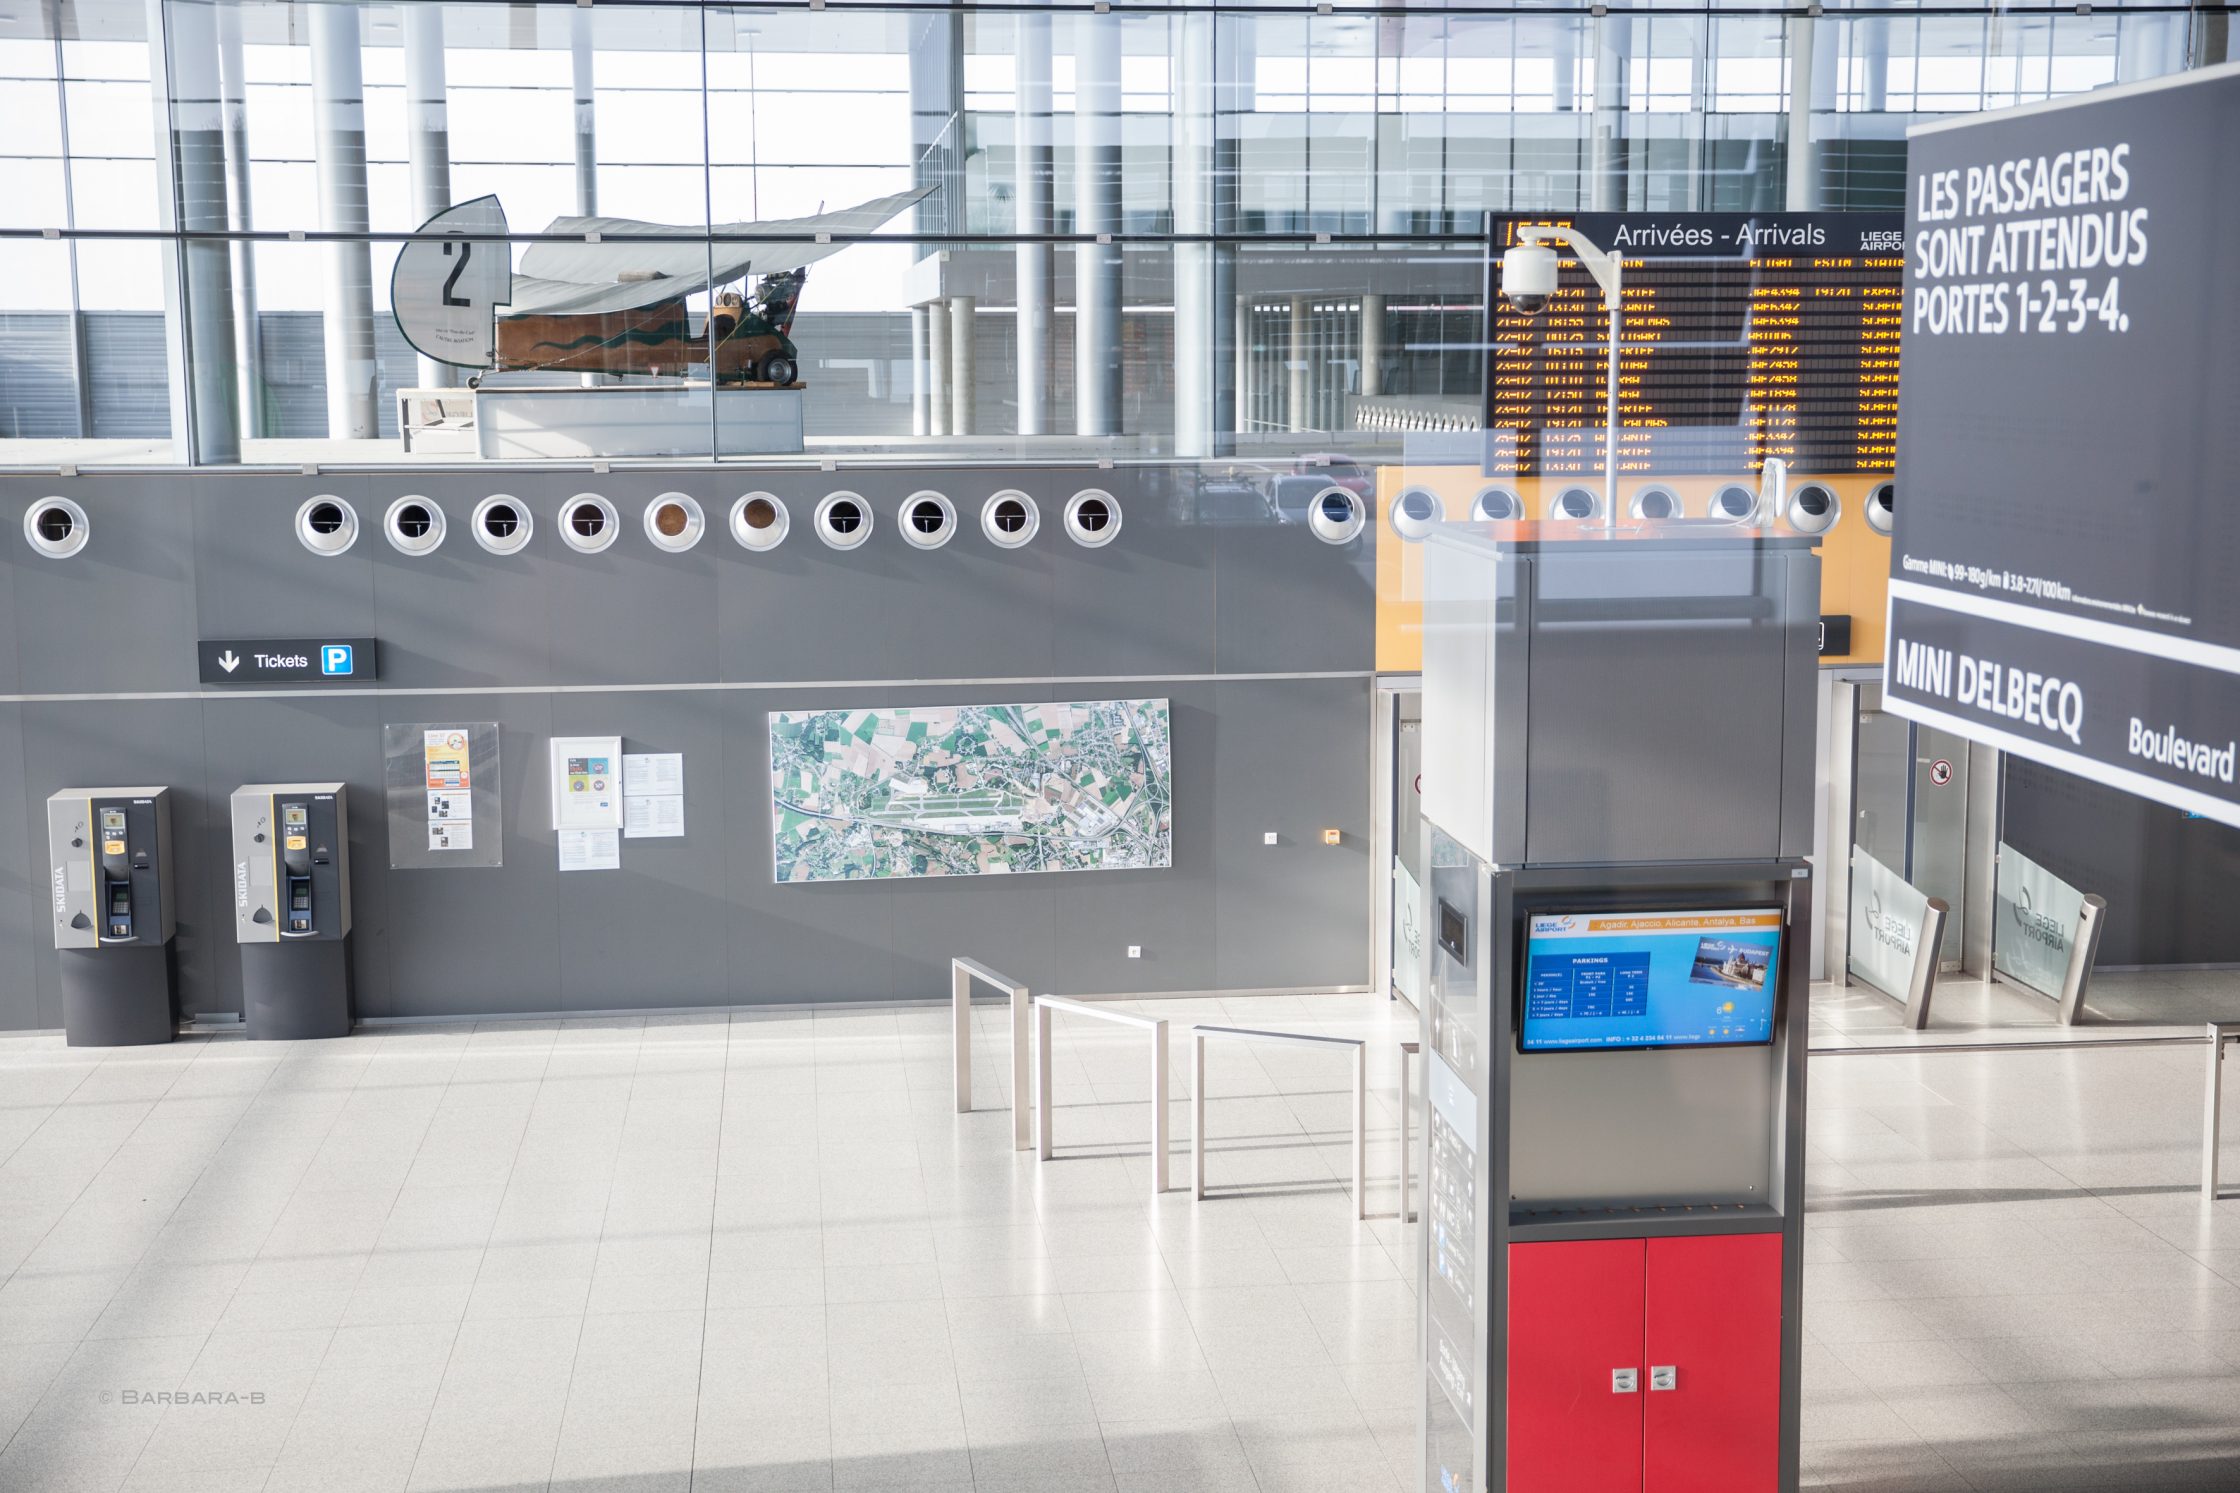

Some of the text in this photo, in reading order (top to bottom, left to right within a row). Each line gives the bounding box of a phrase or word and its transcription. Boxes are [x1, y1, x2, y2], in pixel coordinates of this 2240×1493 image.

[1917, 143, 2131, 222] LES PASSAGERS
[1614, 223, 1713, 246] Arrivées
[1735, 223, 1826, 246] Arrivals
[1861, 231, 1903, 242] LIEGE
[1914, 207, 2149, 279] SONT ATTENDUS
[442, 229, 471, 308] 2
[1912, 276, 2130, 335] PORTES 1-2-3-4.
[1902, 554, 1929, 574] Gamme
[254, 648, 348, 672] Tickets P
[1896, 638, 2084, 745] MINI DELBECQ
[2128, 716, 2236, 784] Boulevard
[54, 866, 66, 913] SKIDATA
[236, 861, 248, 908] SKIDATA
[1740, 916, 1756, 925] Bas
